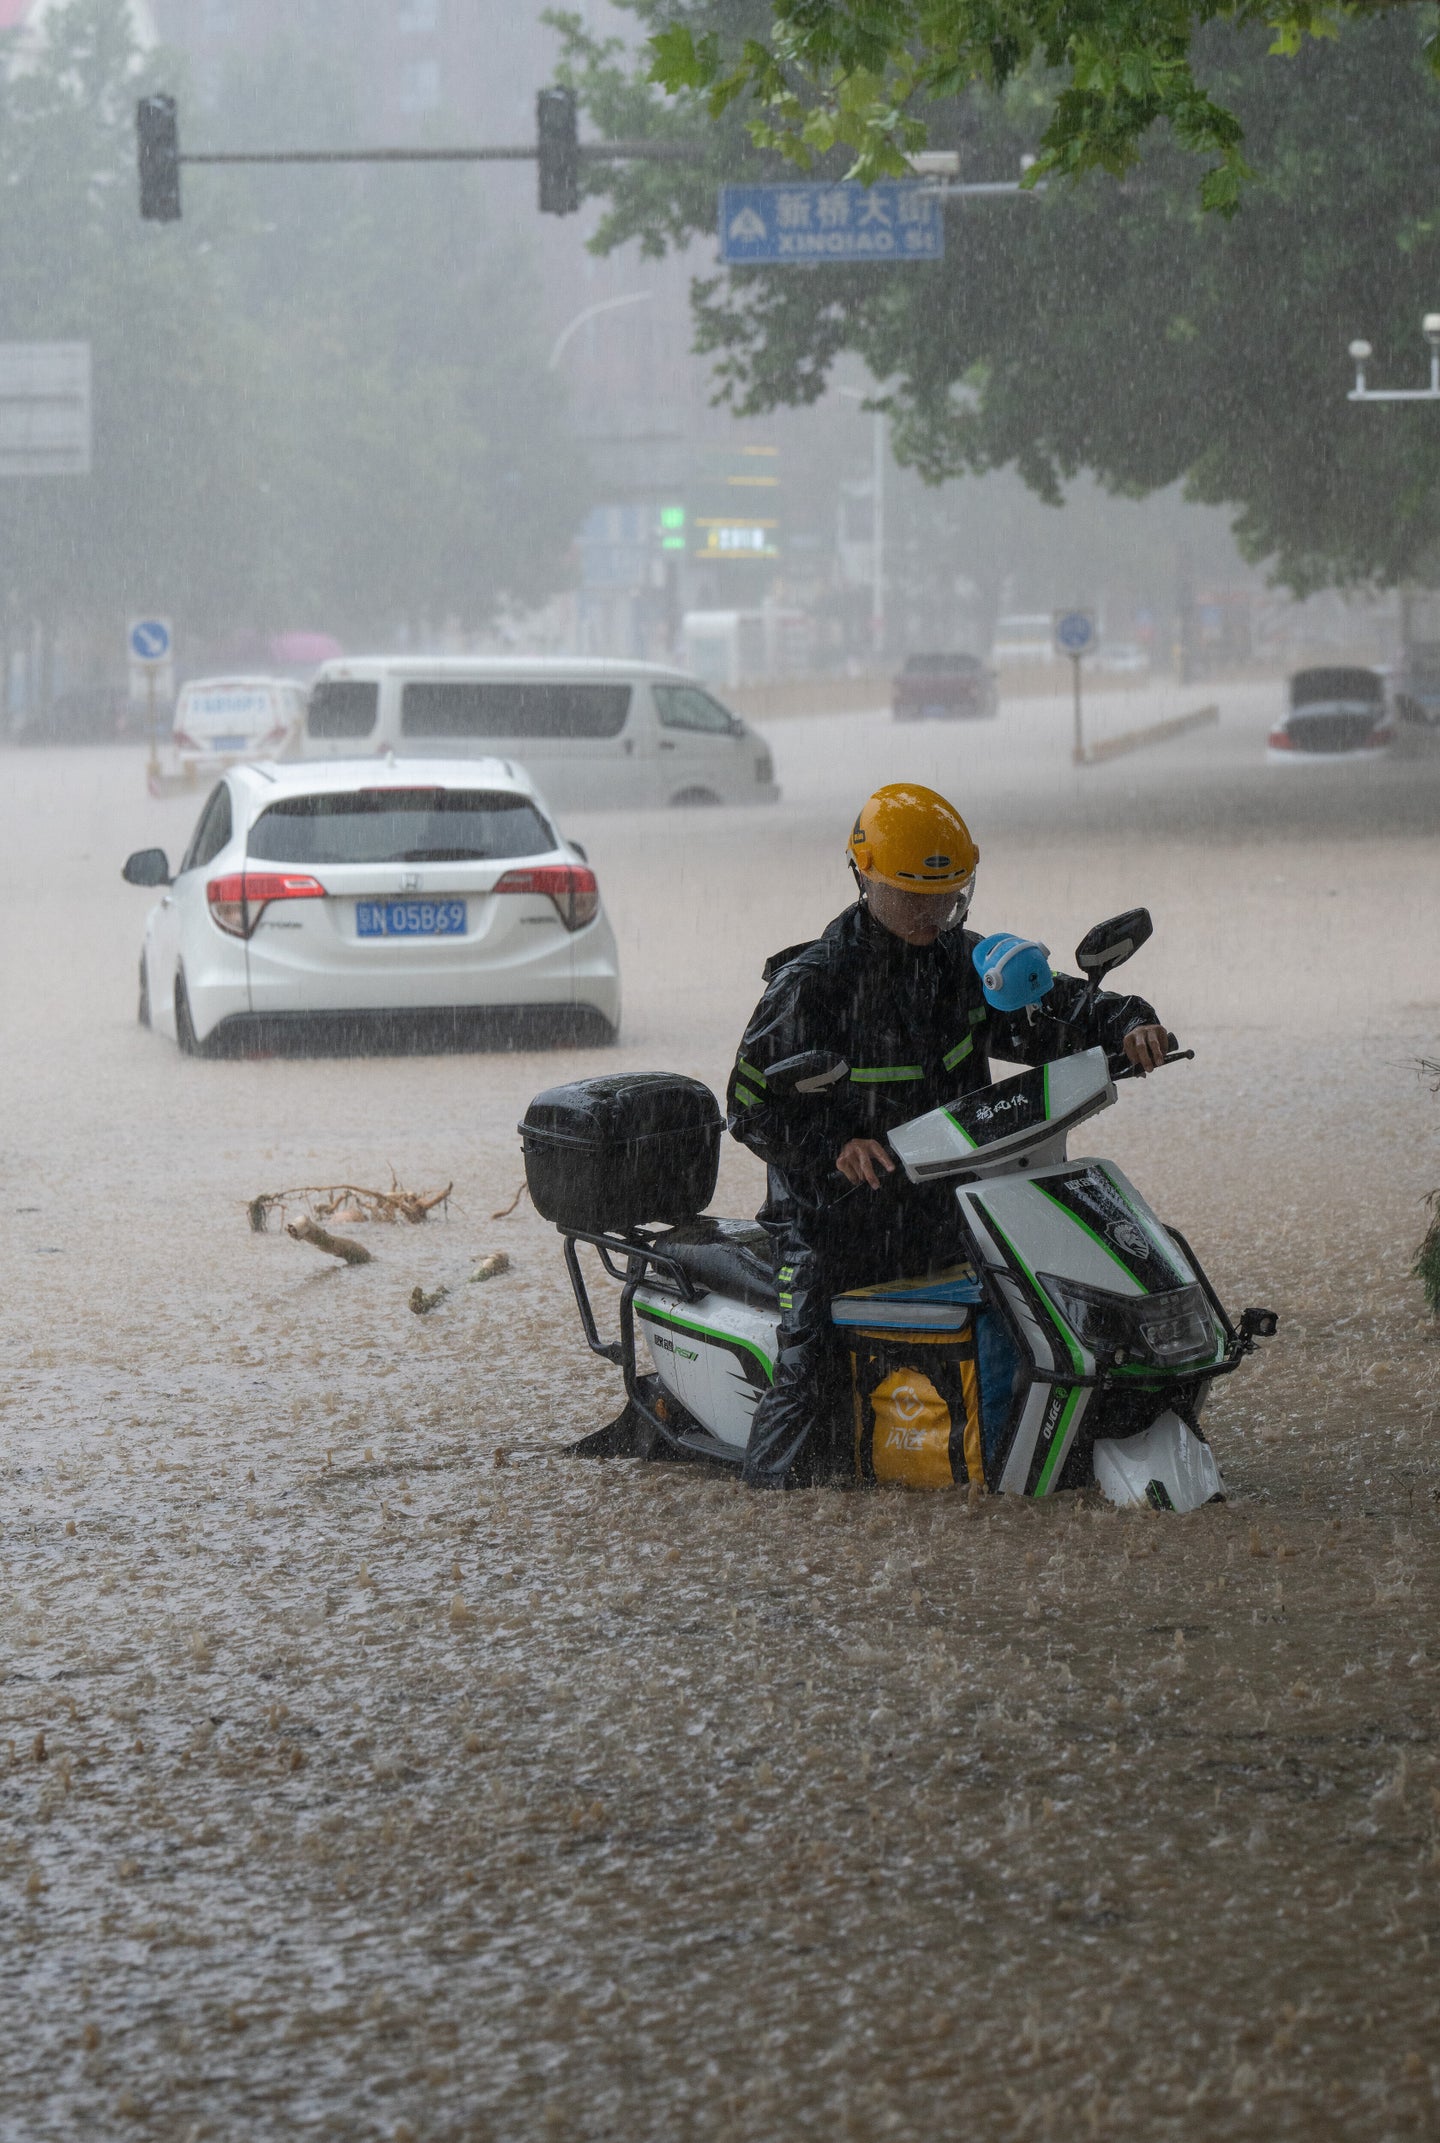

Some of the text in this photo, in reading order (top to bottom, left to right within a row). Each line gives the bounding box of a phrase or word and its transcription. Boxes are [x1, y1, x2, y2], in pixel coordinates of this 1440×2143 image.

[777, 191, 931, 227] 新桥大街
[780, 231, 895, 252] XINQIAO
[1043, 1399, 1061, 1440] OUGE
[885, 1426, 927, 1451] 闪送
